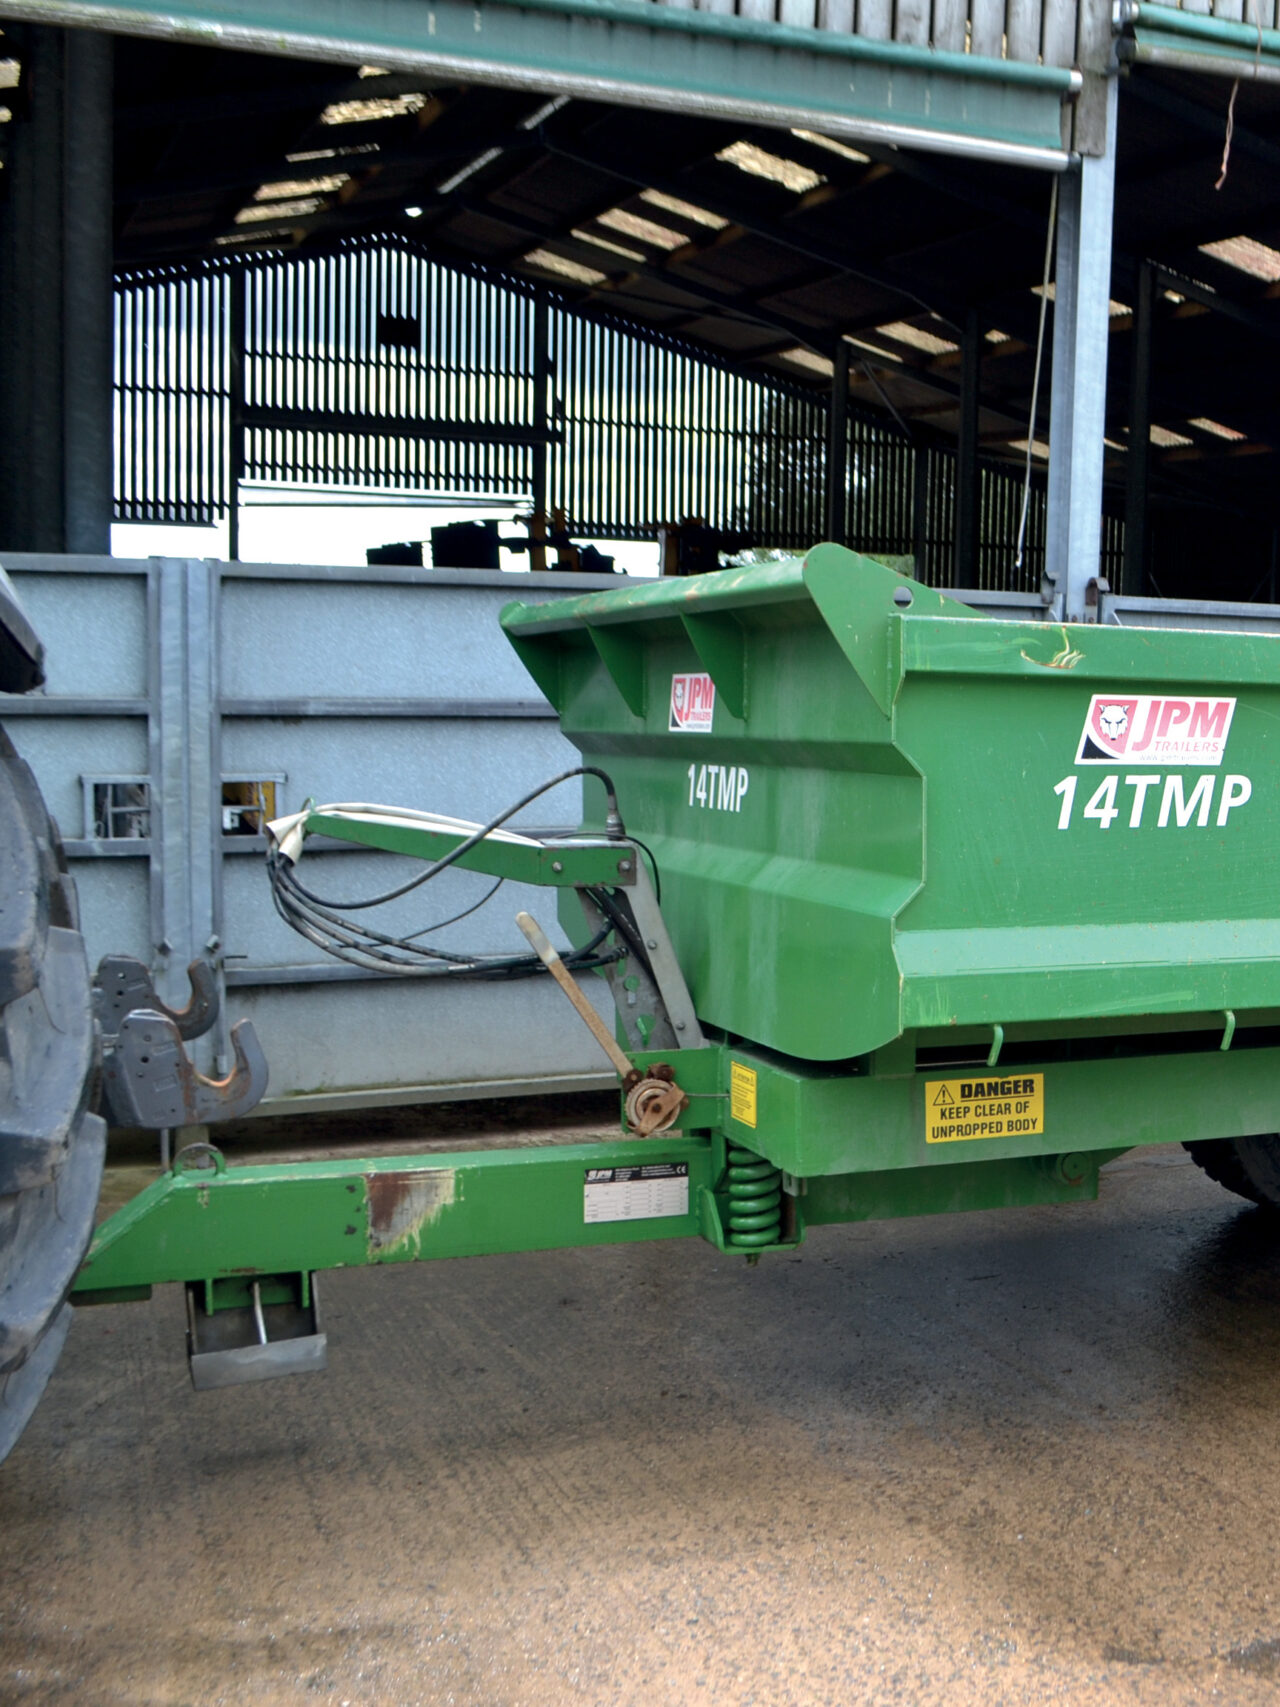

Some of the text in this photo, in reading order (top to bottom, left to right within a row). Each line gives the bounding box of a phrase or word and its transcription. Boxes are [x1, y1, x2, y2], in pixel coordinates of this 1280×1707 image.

[684, 677, 715, 721] JPM
[1131, 700, 1230, 751] JPM
[1155, 741, 1219, 752] TRAILERS
[688, 763, 749, 813] 14TMP
[1053, 774, 1252, 830] 14TMP
[960, 1079, 1034, 1099] DANGER
[940, 1101, 1030, 1120] KEEP CLEAR OF
[932, 1118, 1038, 1139] UNPROPPED BODY
